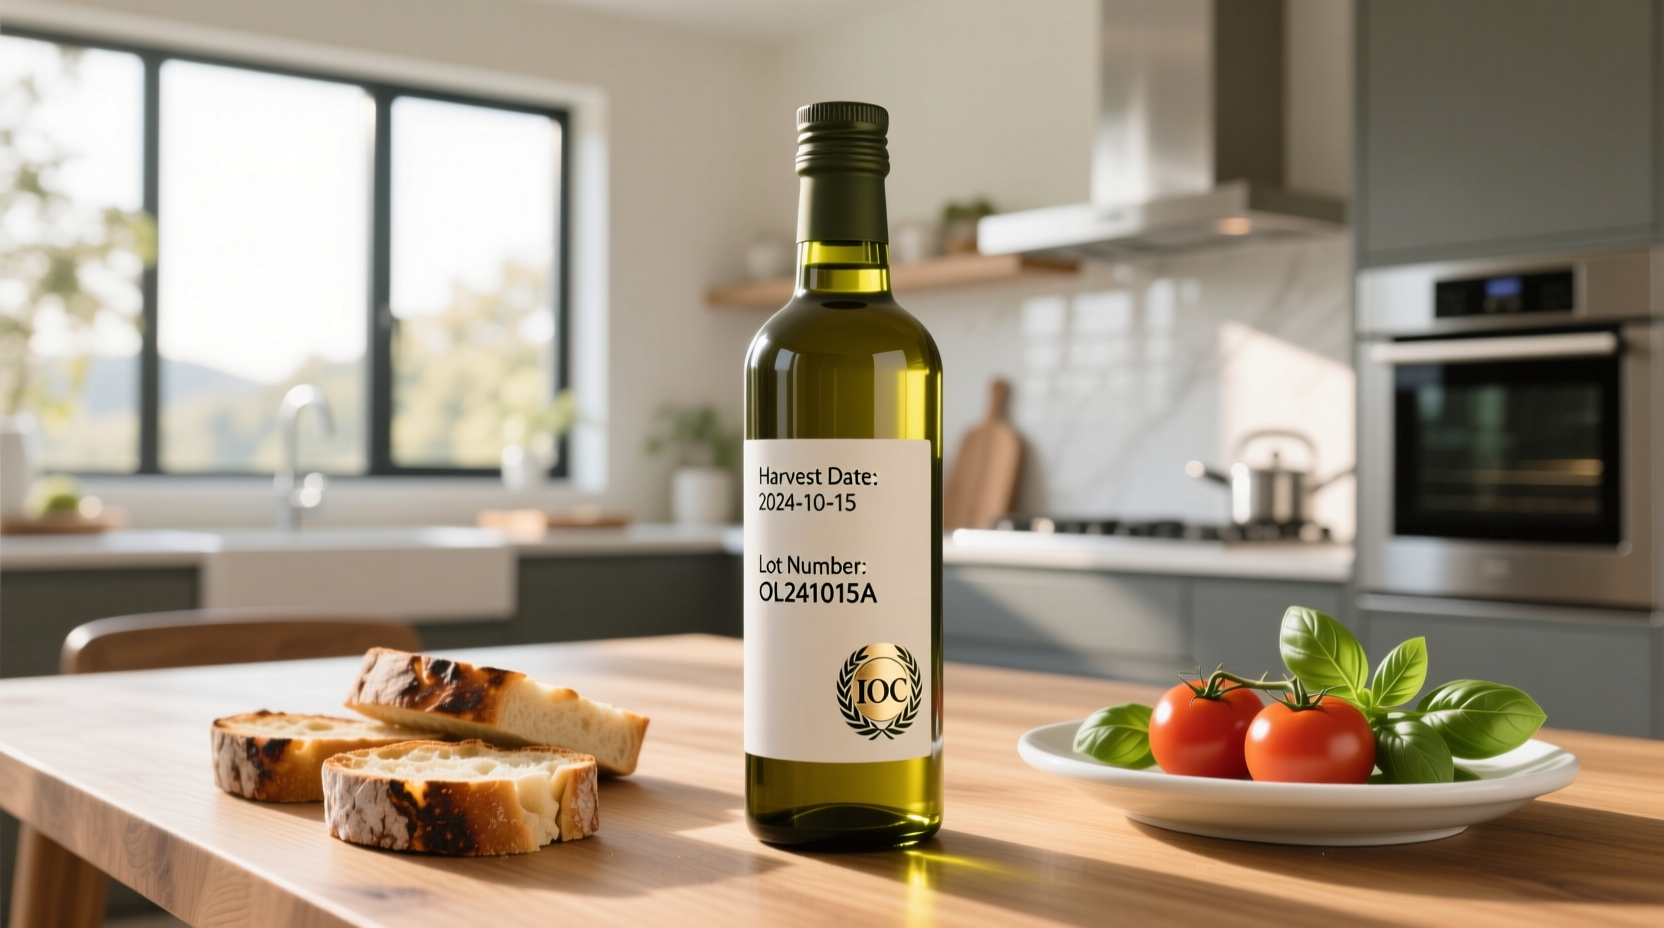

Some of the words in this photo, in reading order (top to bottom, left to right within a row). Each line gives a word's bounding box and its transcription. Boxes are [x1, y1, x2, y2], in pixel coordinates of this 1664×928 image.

[759, 467, 822, 486] Harvest
[828, 467, 878, 486] Date:
[758, 493, 857, 512] 2024-10-15
[759, 555, 782, 574] Lot
[787, 556, 867, 575] Number:
[759, 581, 878, 604] OL241015A
[857, 677, 908, 704] IOC
